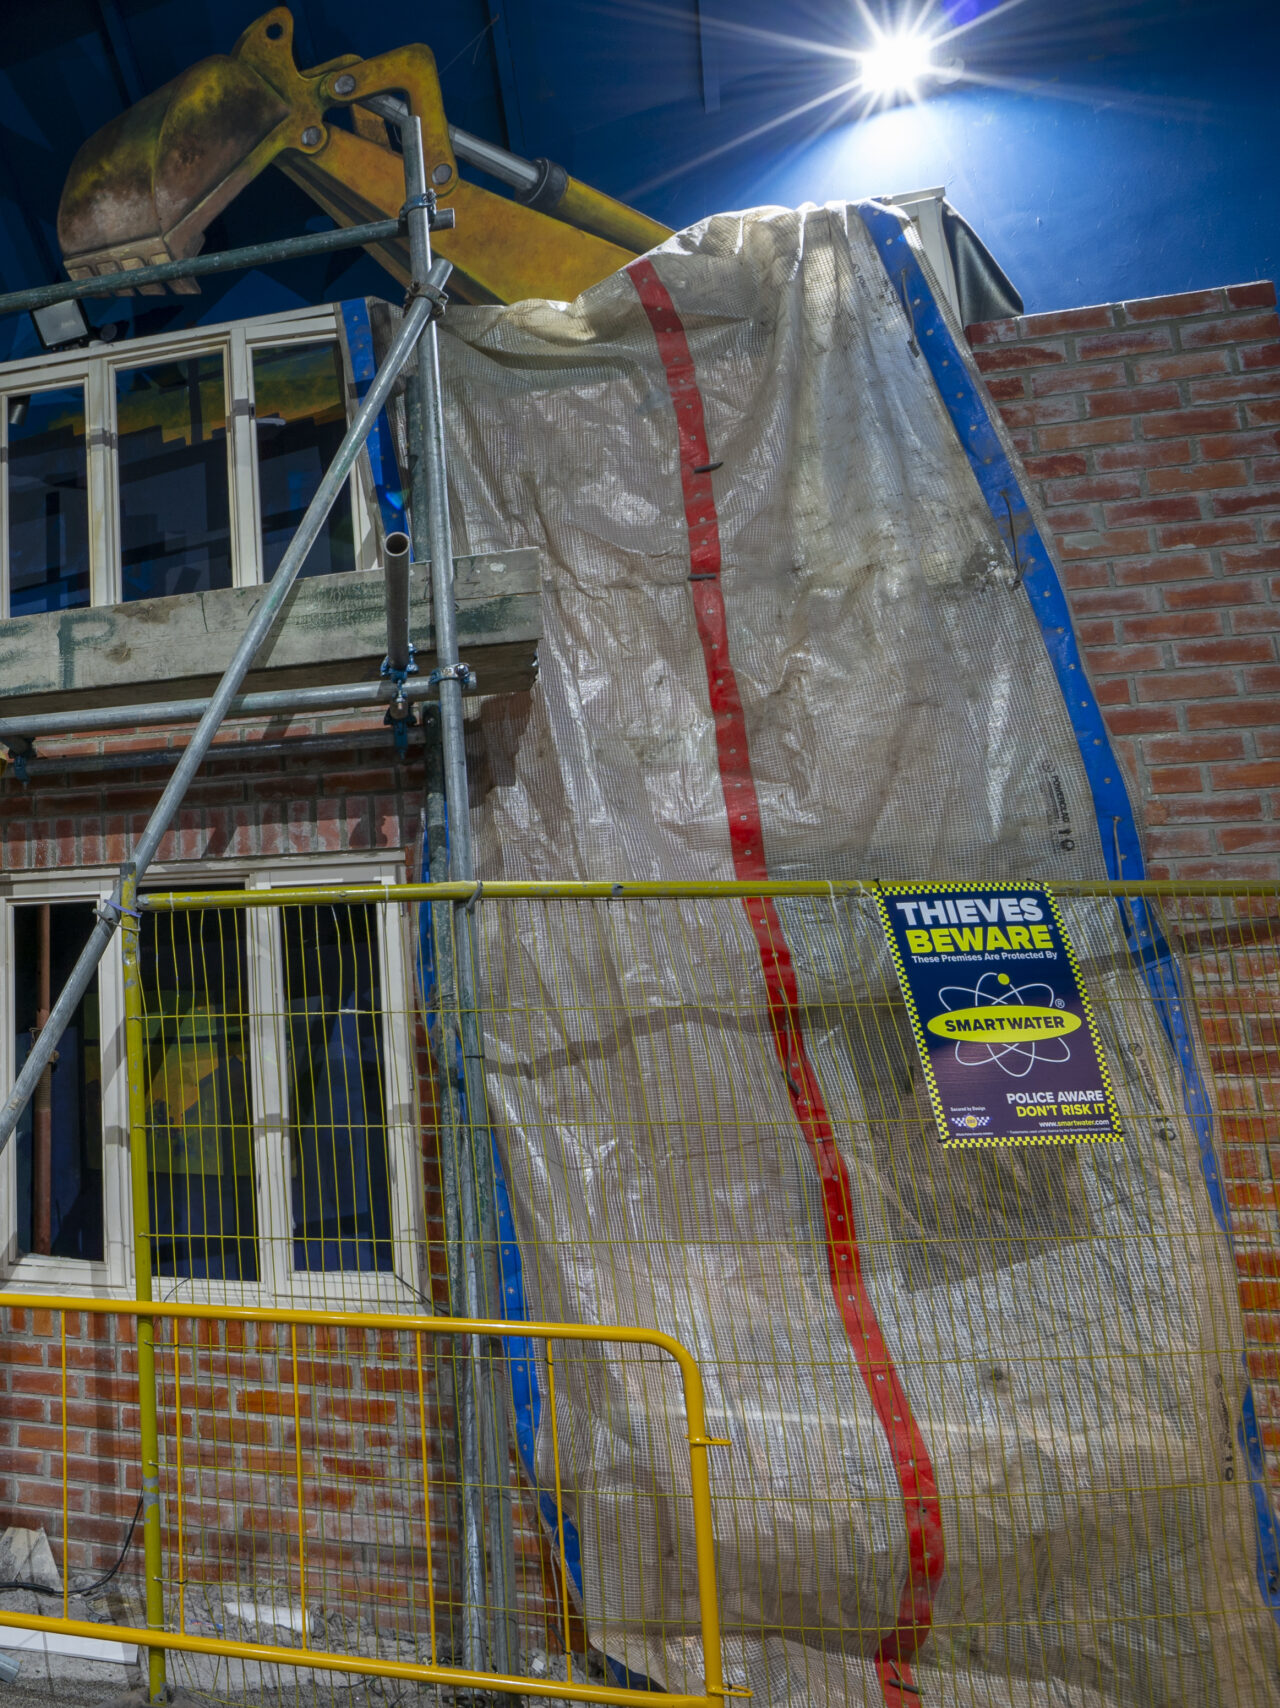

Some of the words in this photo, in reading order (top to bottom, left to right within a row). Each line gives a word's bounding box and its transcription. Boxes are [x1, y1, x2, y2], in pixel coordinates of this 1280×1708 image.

[1051, 775, 1070, 823] POWERCLAD
[896, 898, 1043, 925] THIEVES
[905, 925, 1054, 953] BEWARE
[912, 955, 939, 964] These
[942, 953, 982, 963] Premises
[984, 953, 1000, 961] Are
[1002, 951, 1043, 960] Protected
[1045, 951, 1057, 960] By
[945, 1016, 1065, 1033] SMARTWATER
[1006, 1092, 1054, 1104] POLICE
[1058, 1090, 1103, 1103] AWARE
[1062, 1104, 1092, 1115] RISK
[1094, 1103, 1105, 1114] IT
[1039, 1120, 1109, 1128] www.smartwater.com
